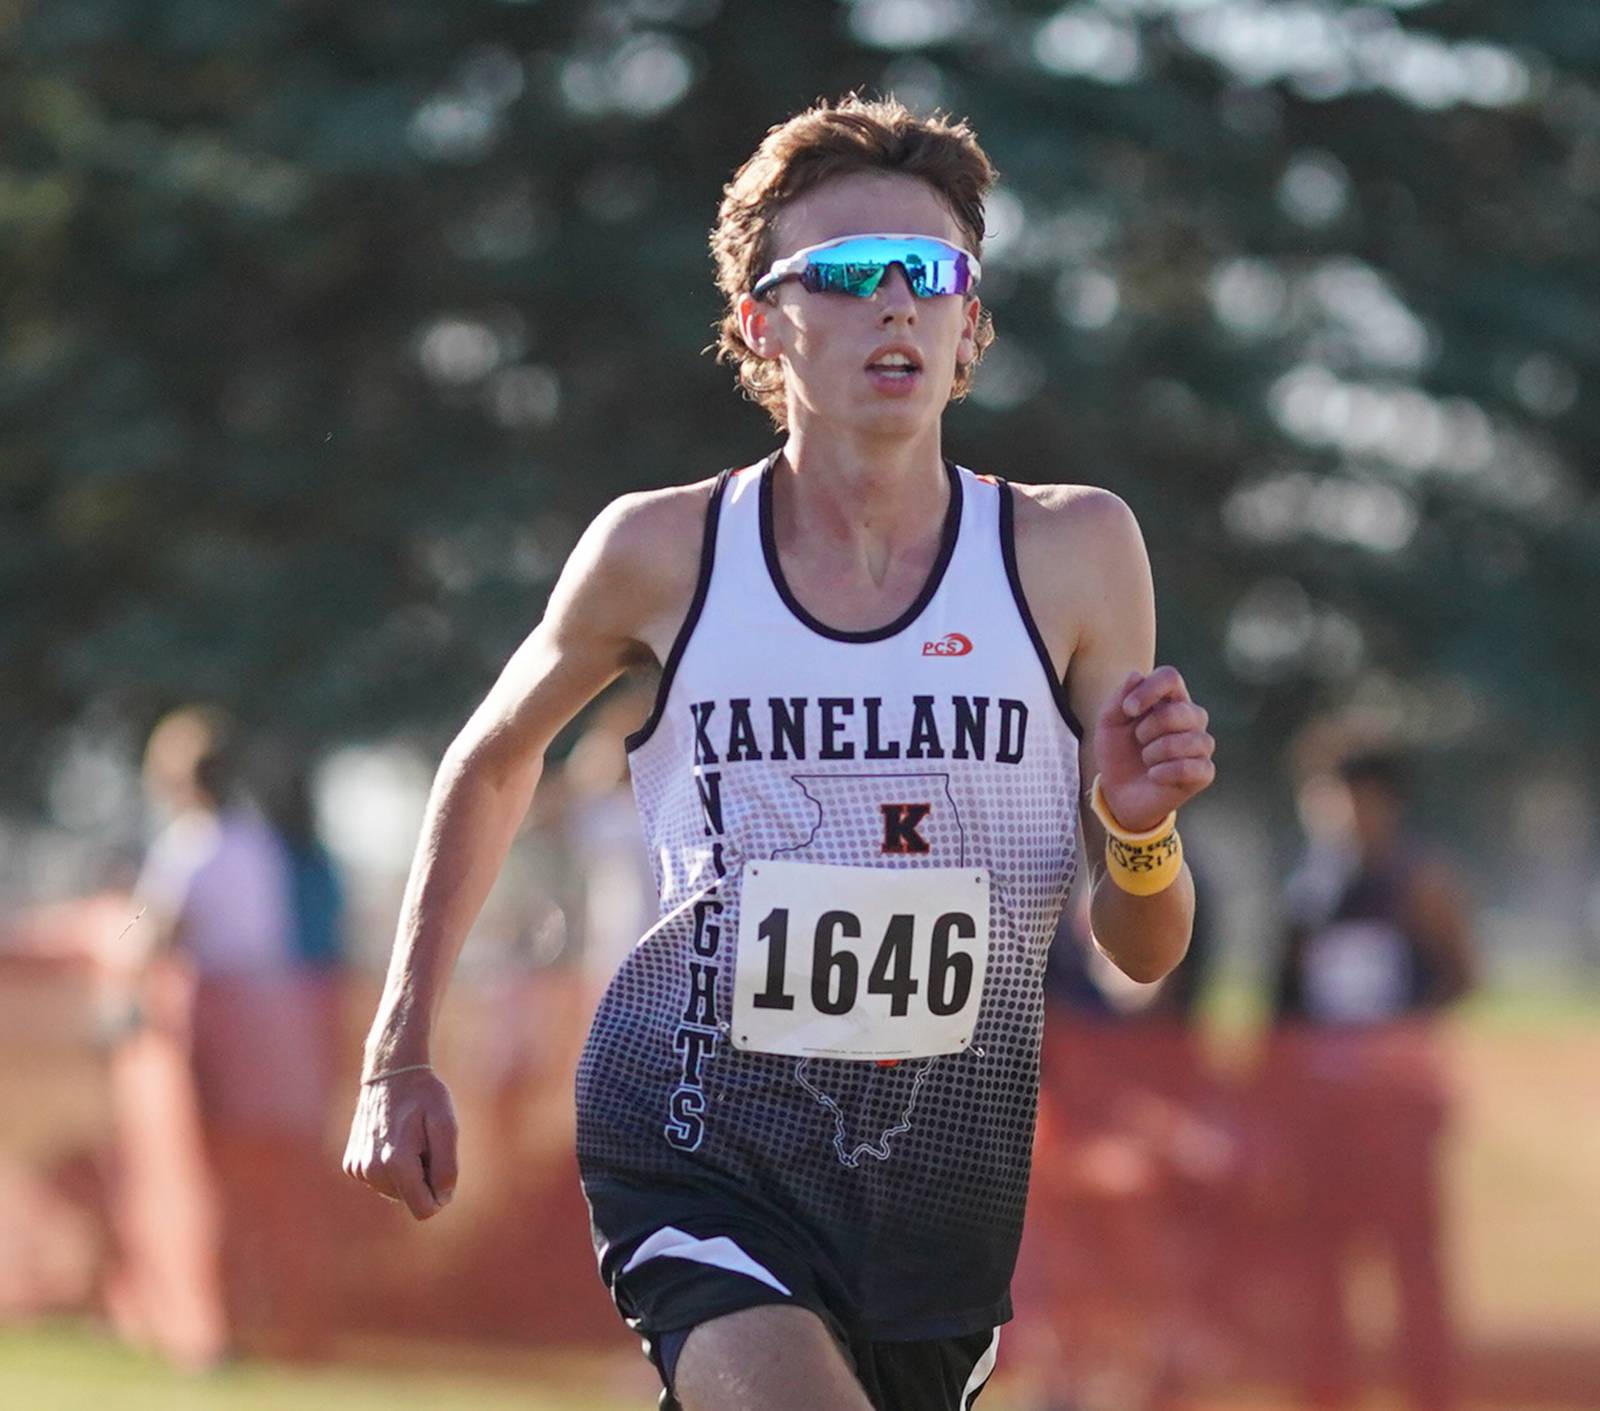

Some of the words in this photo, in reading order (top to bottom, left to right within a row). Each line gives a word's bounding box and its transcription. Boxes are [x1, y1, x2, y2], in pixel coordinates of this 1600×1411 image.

[922, 640, 960, 656] PCS
[690, 695, 1029, 765] KANELAND
[880, 803, 932, 855] K
[753, 907, 977, 1017] 1646
